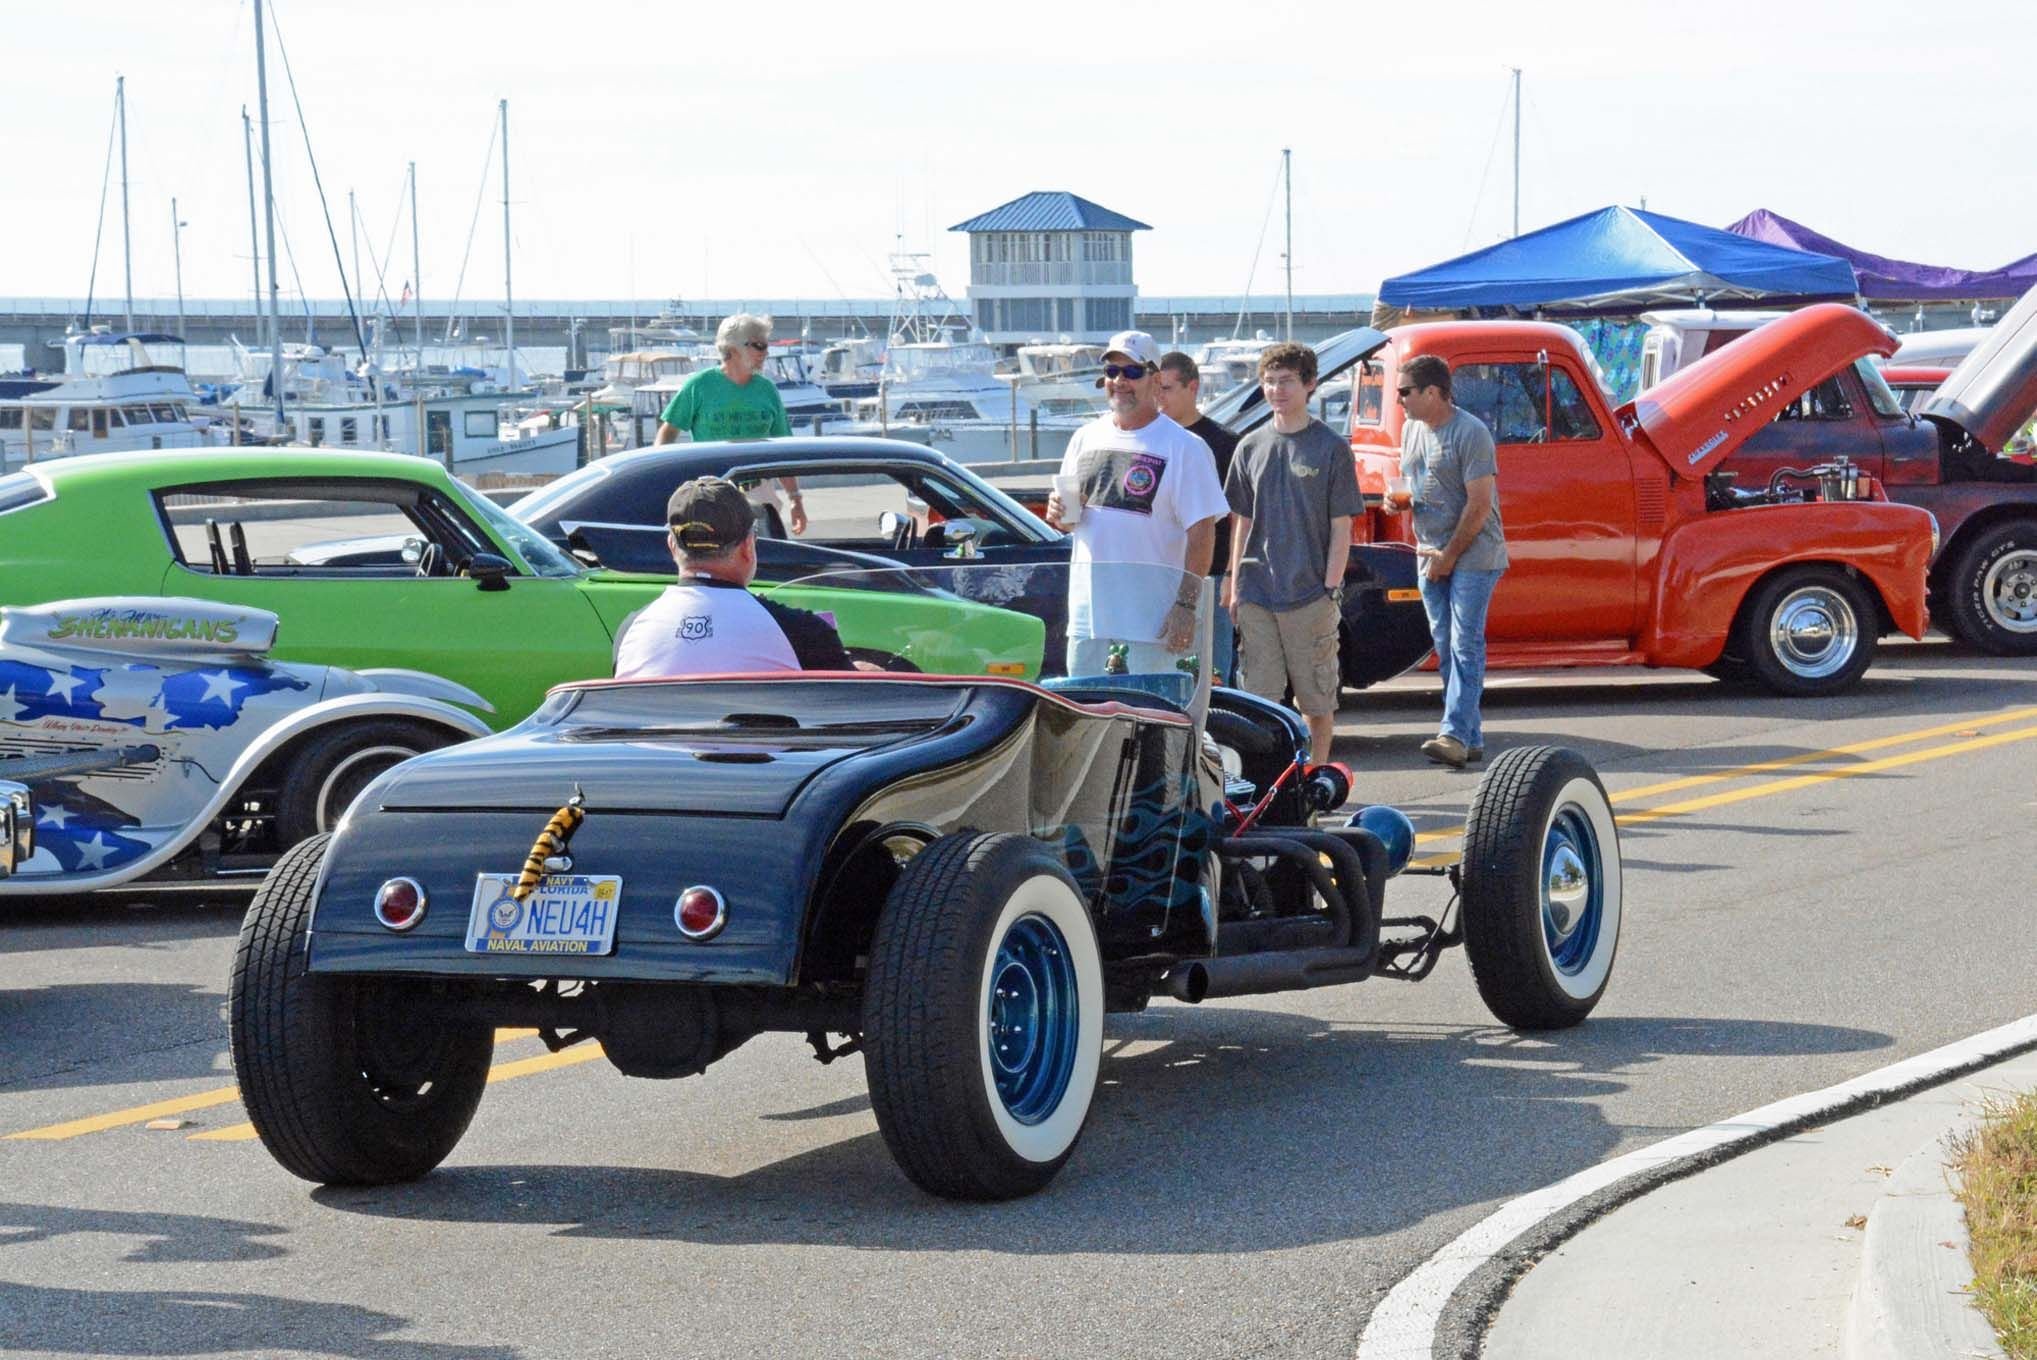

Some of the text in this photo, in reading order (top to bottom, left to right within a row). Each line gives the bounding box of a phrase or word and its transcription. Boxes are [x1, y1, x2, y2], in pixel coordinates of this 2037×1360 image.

[1972, 540, 2016, 631] TIGER PAW GTS
[686, 622, 704, 634] 90
[546, 876, 575, 886] NAVY
[535, 886, 589, 896] LORIDA
[526, 899, 609, 936] NEU4H
[487, 939, 588, 953] NAVAL AVIATION
